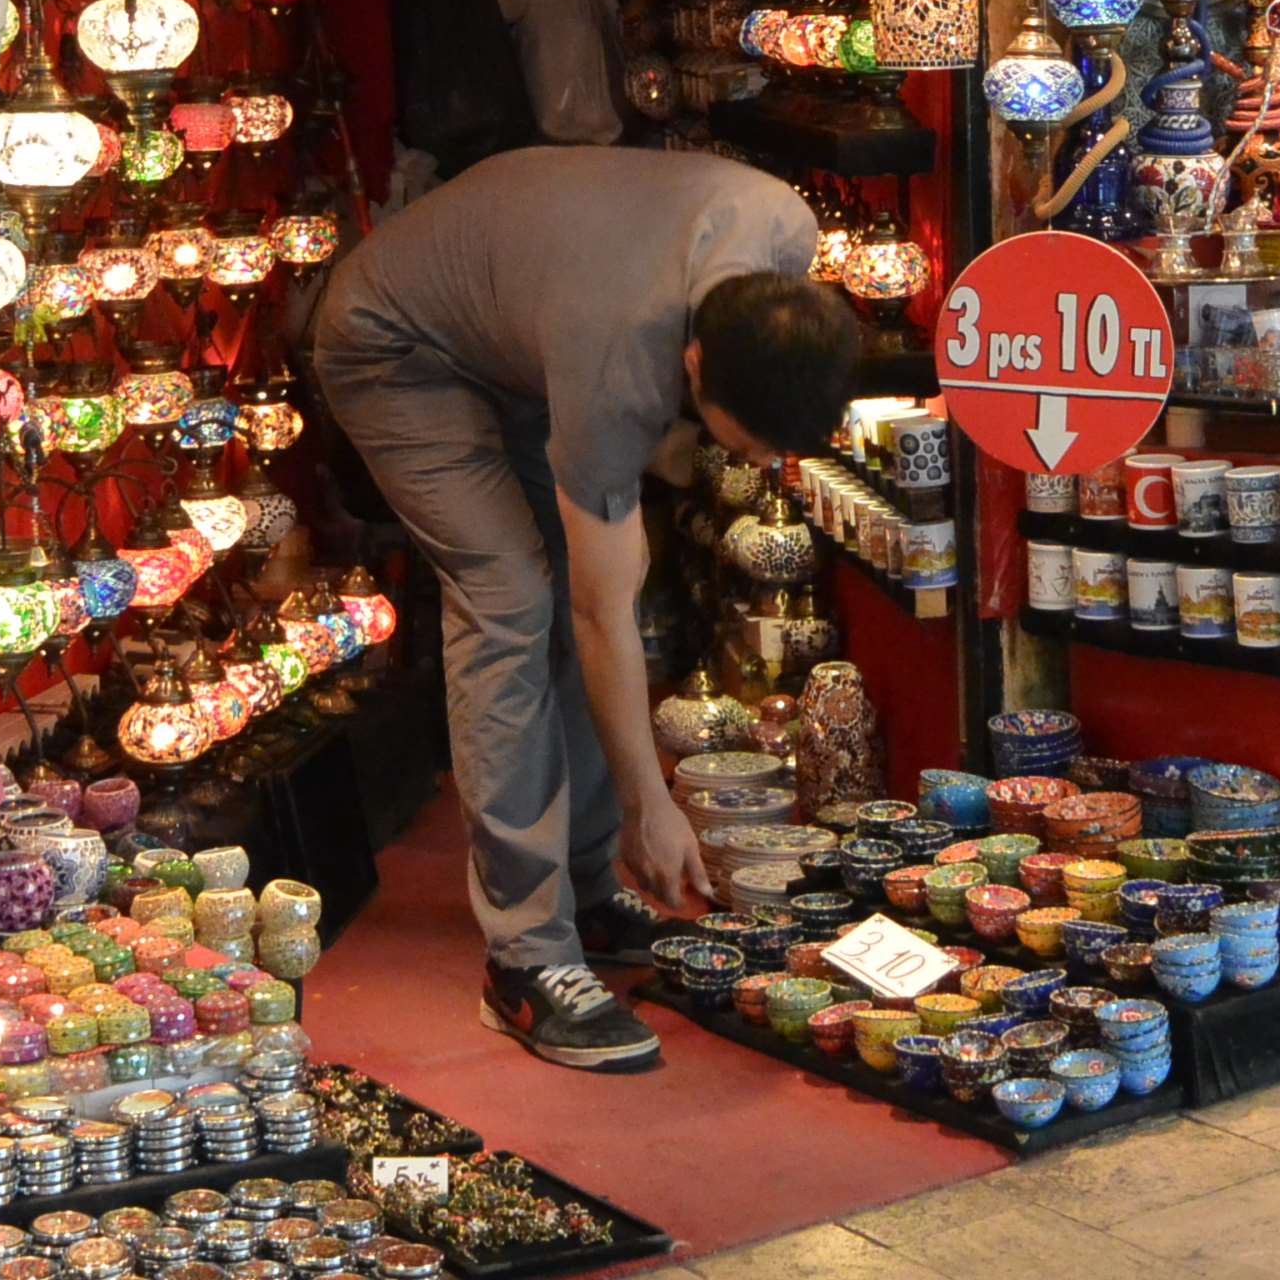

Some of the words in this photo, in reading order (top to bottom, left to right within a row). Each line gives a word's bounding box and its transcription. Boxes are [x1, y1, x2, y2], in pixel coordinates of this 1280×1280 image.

[946, 285, 981, 367] 3
[987, 332, 1043, 379] pcs
[1056, 292, 1120, 376] 10
[1130, 327, 1167, 378] TL
[839, 930, 885, 958] 3
[876, 949, 926, 980] 10
[416, 1172, 432, 1184] TL
